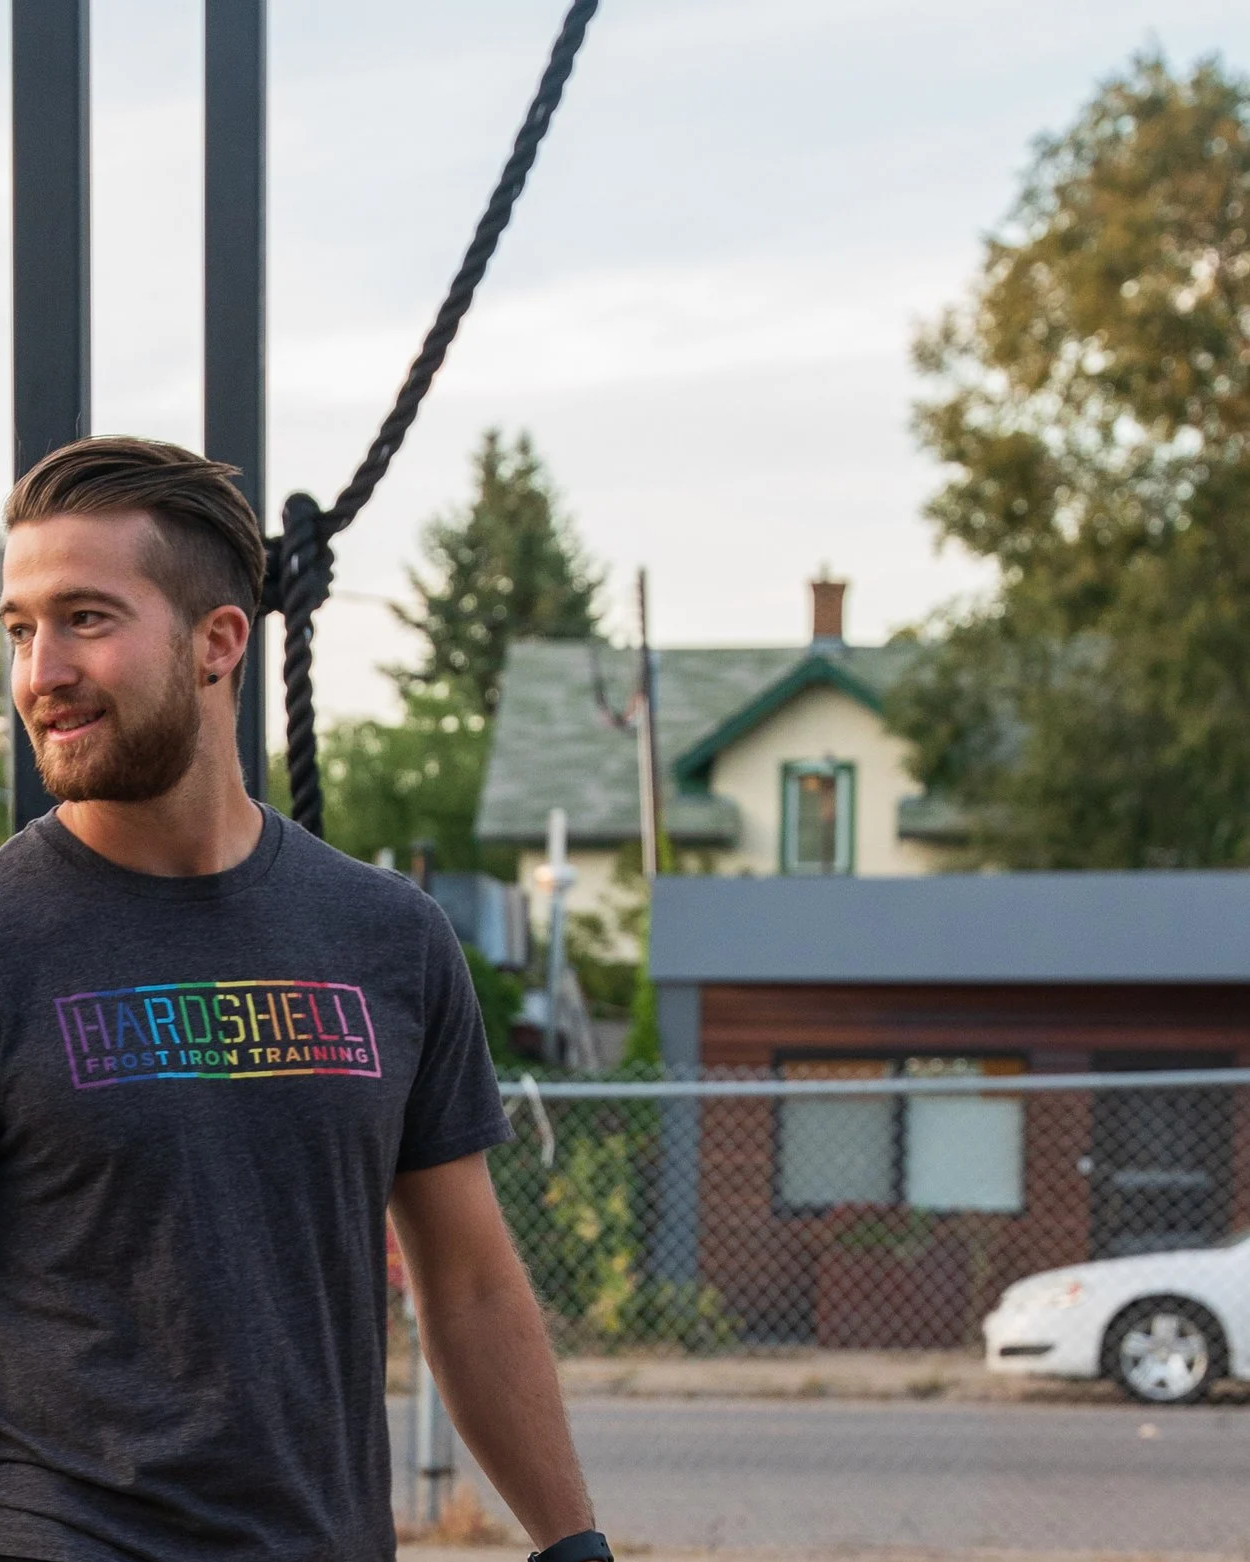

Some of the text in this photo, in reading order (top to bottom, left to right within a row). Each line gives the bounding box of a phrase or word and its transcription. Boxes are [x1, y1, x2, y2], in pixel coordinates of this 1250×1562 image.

[71, 992, 364, 1053] HARDSHELL
[85, 1046, 369, 1074] FROST IRON TRAINING
